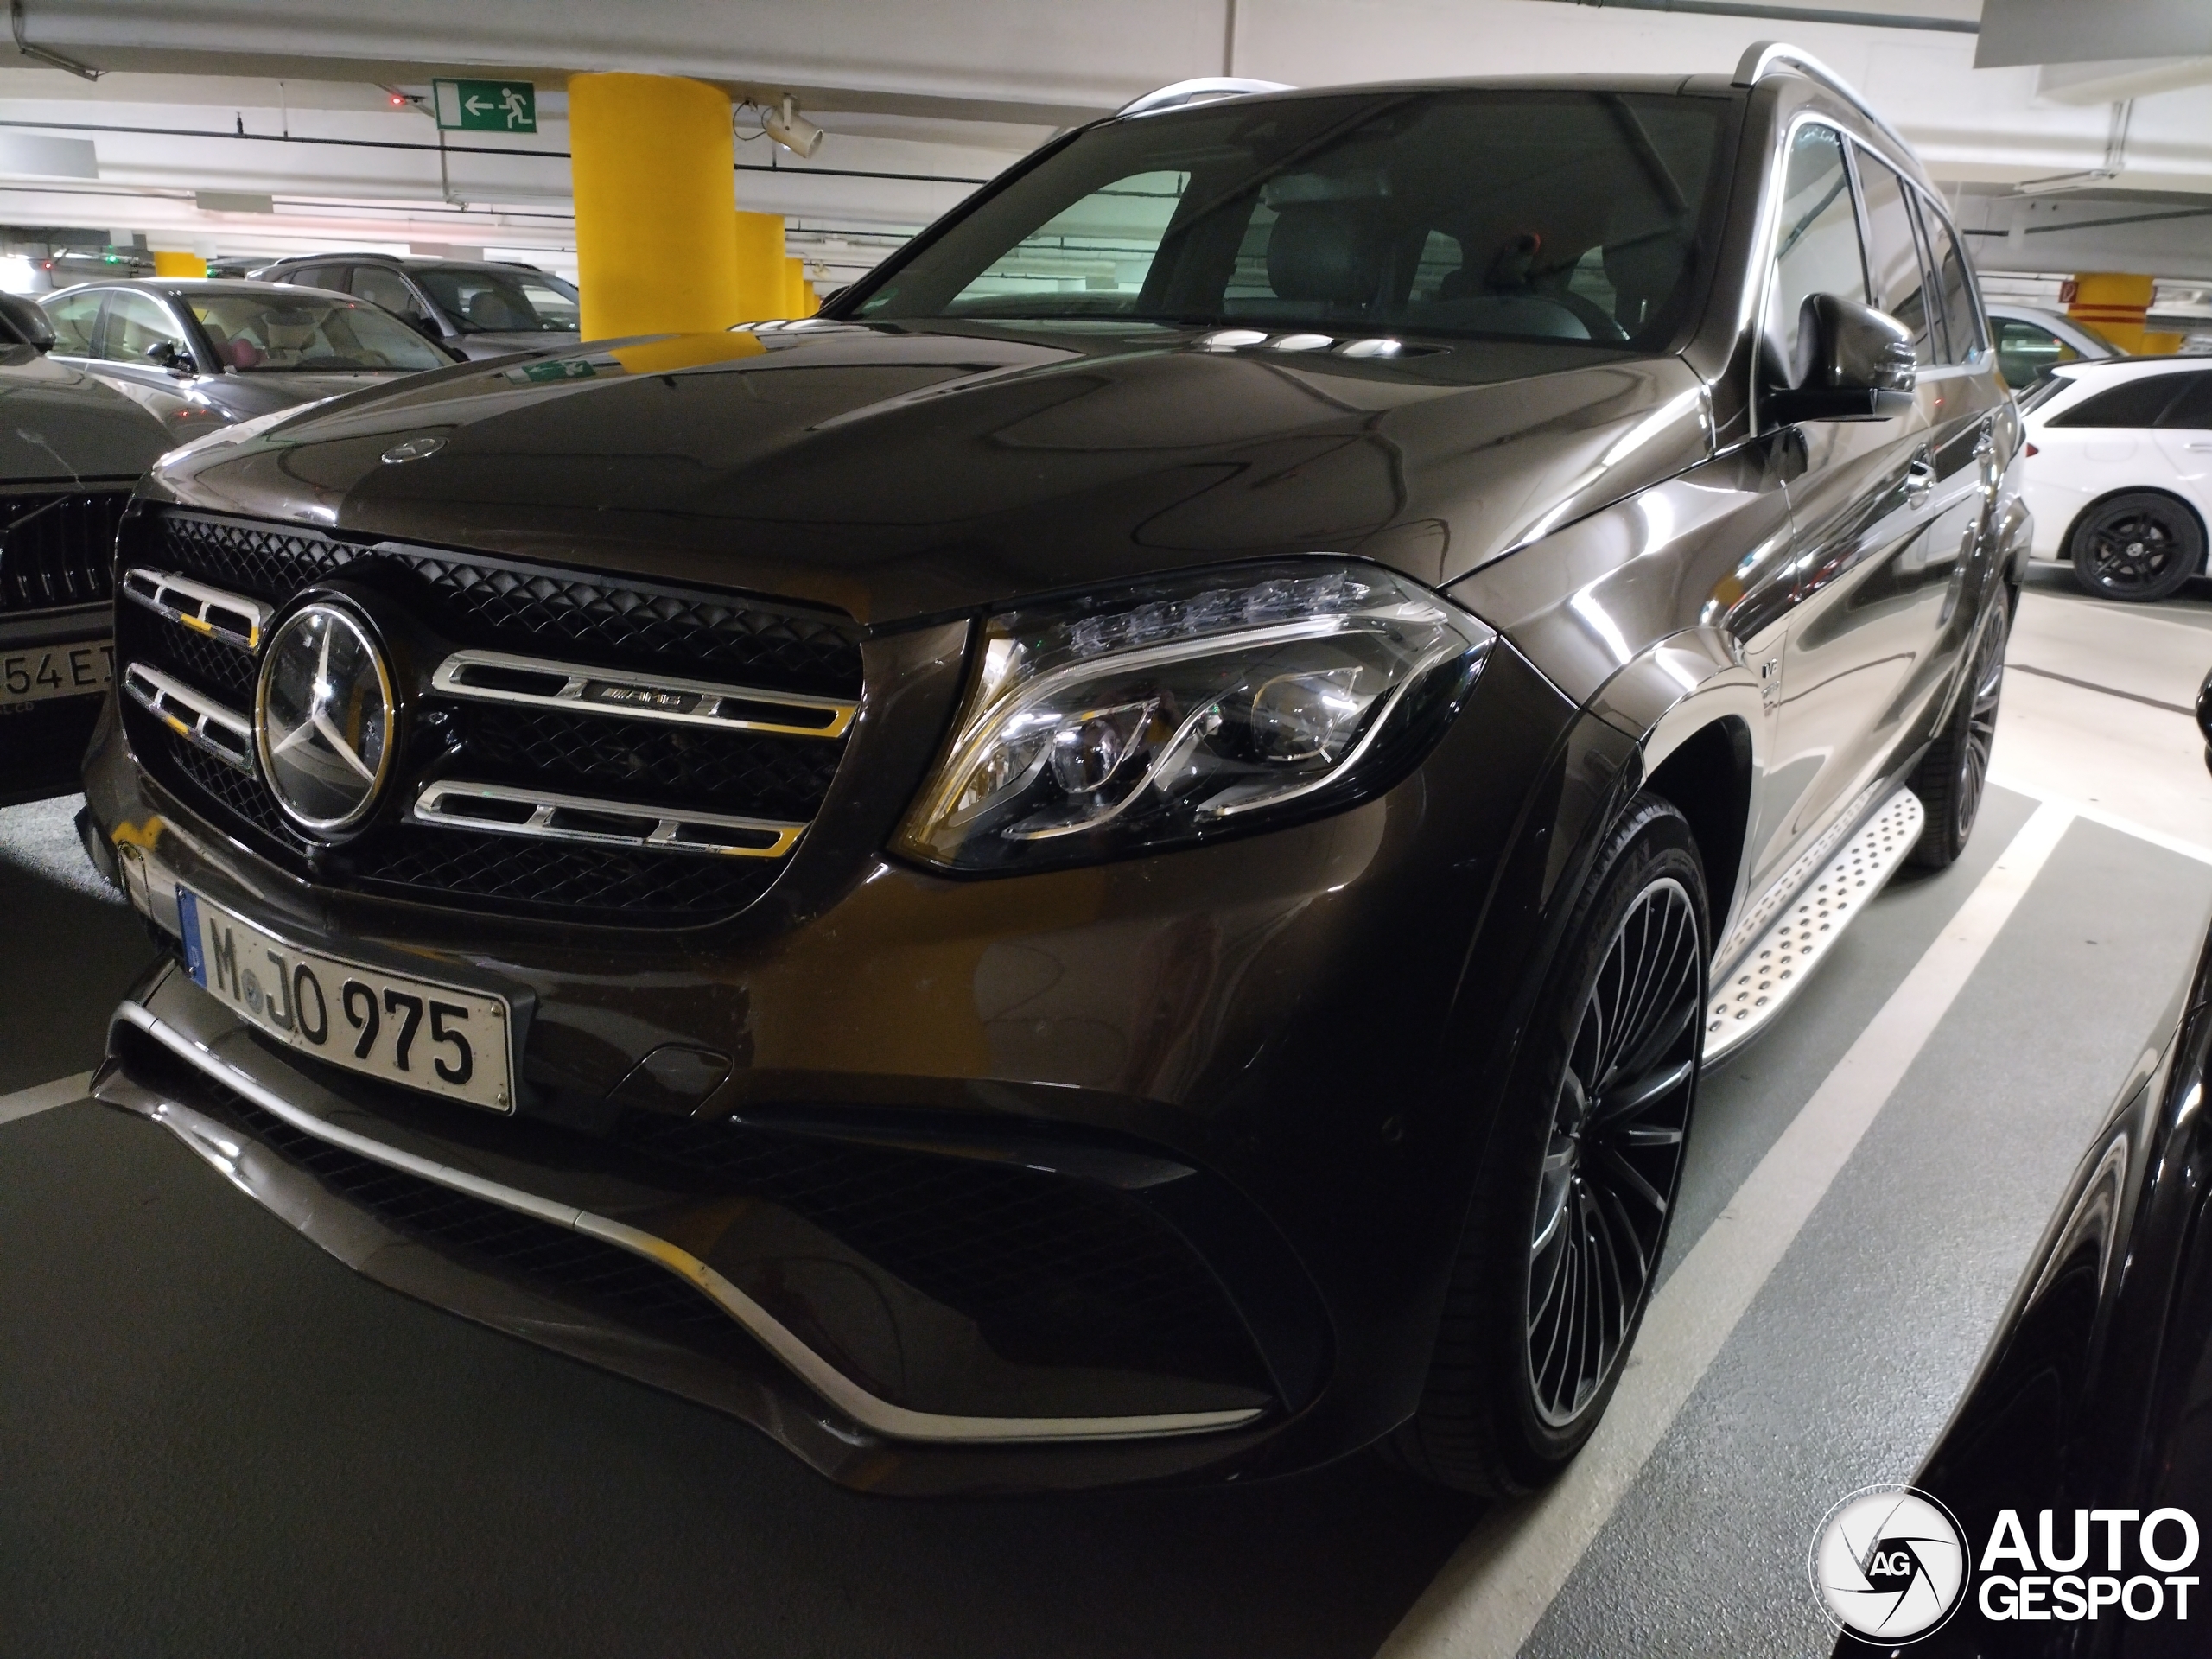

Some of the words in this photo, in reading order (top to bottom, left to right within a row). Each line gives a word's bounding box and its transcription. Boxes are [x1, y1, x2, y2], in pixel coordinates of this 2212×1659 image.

[209, 916, 243, 1001] M
[266, 947, 329, 1046] JO
[342, 977, 474, 1085] 975
